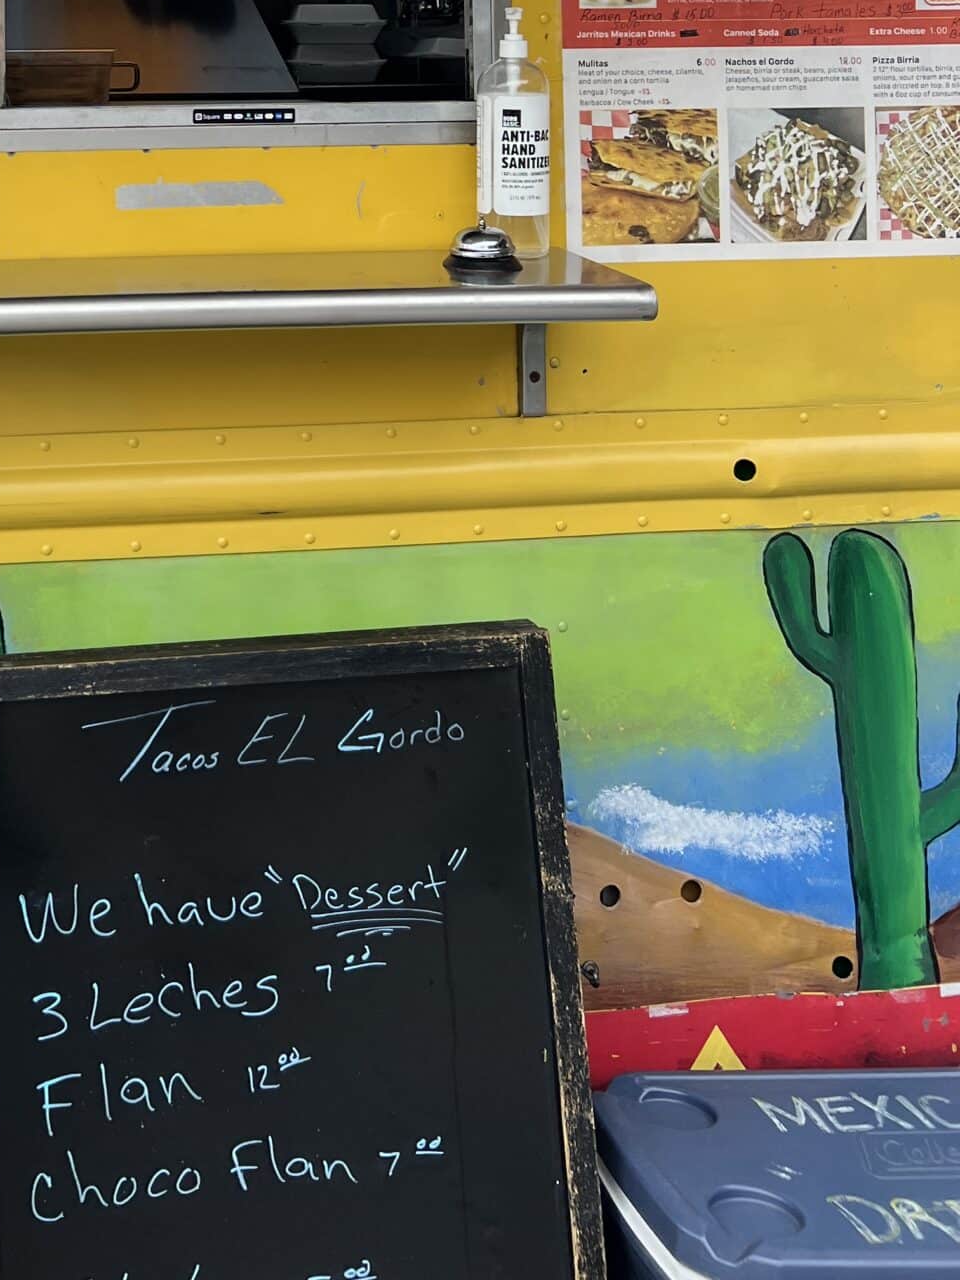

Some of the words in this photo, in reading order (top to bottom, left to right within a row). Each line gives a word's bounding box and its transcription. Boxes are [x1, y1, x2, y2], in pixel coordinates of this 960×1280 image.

[576, 30, 609, 38] Jarritos
[610, 30, 646, 38] Mexican
[648, 29, 676, 38] Drinks
[724, 28, 756, 37] Canned
[758, 28, 779, 37] Soda
[869, 27, 892, 36] Extra
[894, 27, 926, 36] Cheese
[930, 26, 948, 34] 1.00
[578, 60, 608, 68] Mulitas
[725, 58, 757, 66] Nachos
[758, 58, 766, 66] el
[872, 56, 895, 64] Pizza
[896, 56, 920, 64] Birria
[502, 144, 536, 156] HAND
[82, 700, 220, 782] Tacos
[237, 713, 315, 765] EL
[338, 709, 465, 753] Gordo
[18, 883, 117, 944] We
[134, 873, 264, 925] have
[32, 992, 68, 1041] 3
[87, 963, 280, 1033] Leches
[36, 1063, 202, 1137] Flan
